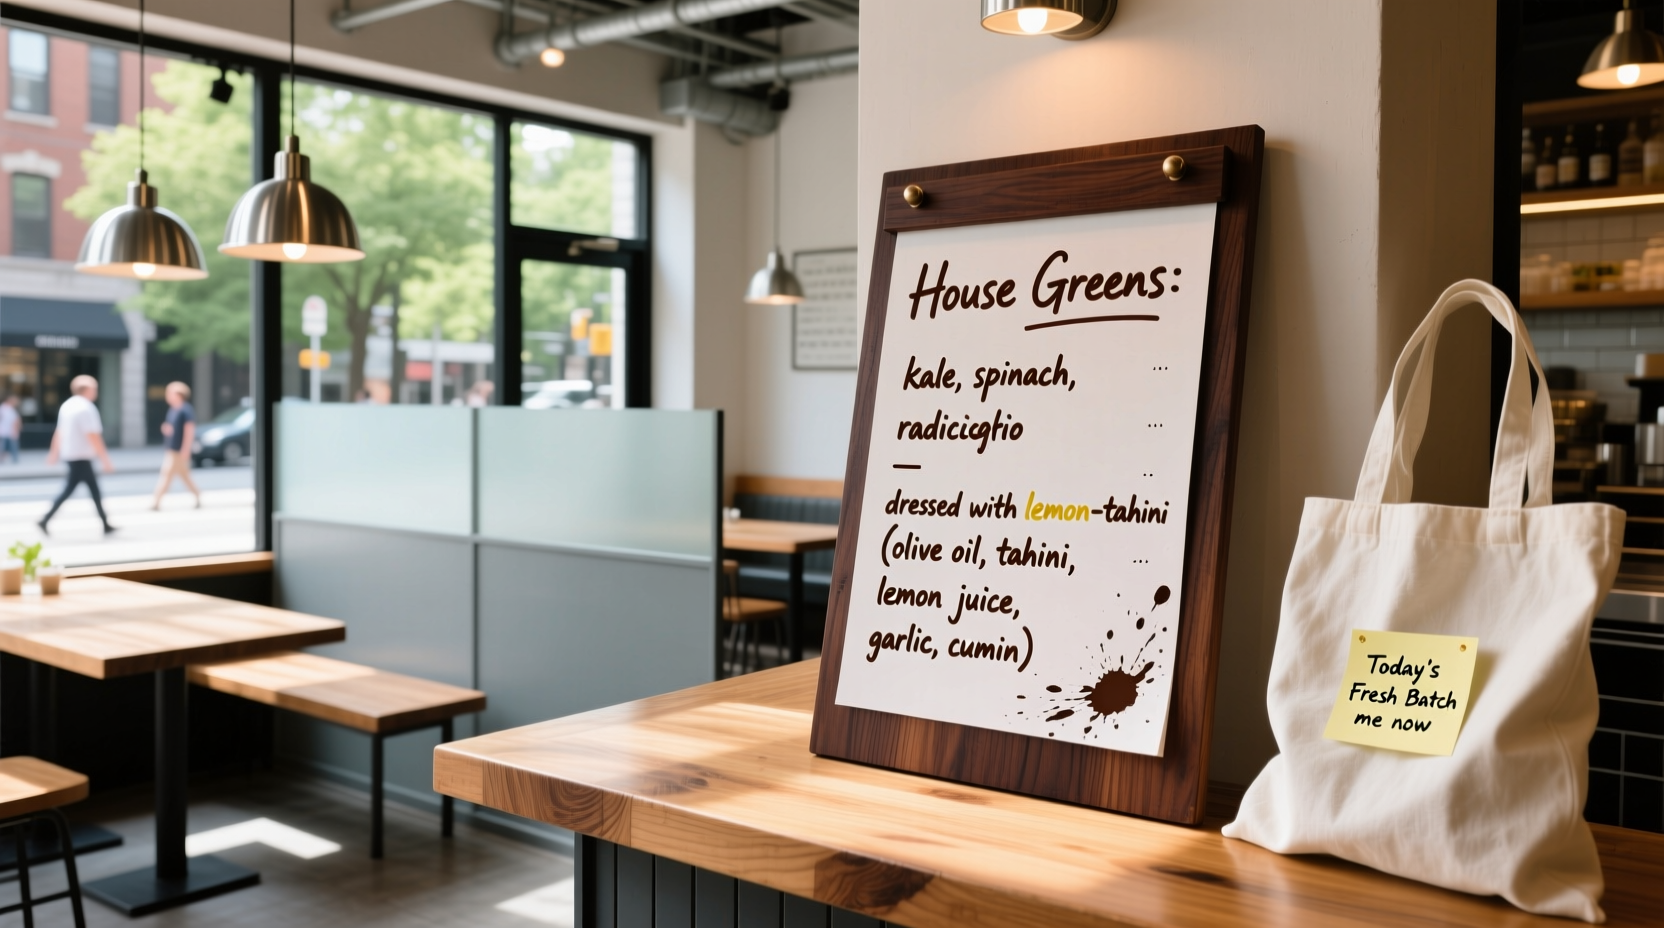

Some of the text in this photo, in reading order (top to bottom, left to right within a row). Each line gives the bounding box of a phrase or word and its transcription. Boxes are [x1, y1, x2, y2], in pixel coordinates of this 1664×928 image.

[908, 259, 1017, 321] House
[1031, 249, 1182, 315] Greens:
[902, 353, 1076, 403] kale, spinach,
[884, 488, 1170, 525] dressed with lemon-tahini
[881, 523, 1075, 577] (olive oil, tahini,
[876, 575, 1020, 625] lemon juice,
[865, 623, 1034, 673] garlic, cumin)
[1367, 654, 1441, 686] Today's
[1348, 682, 1457, 710] Fresh Batch
[1353, 713, 1432, 733] me now
